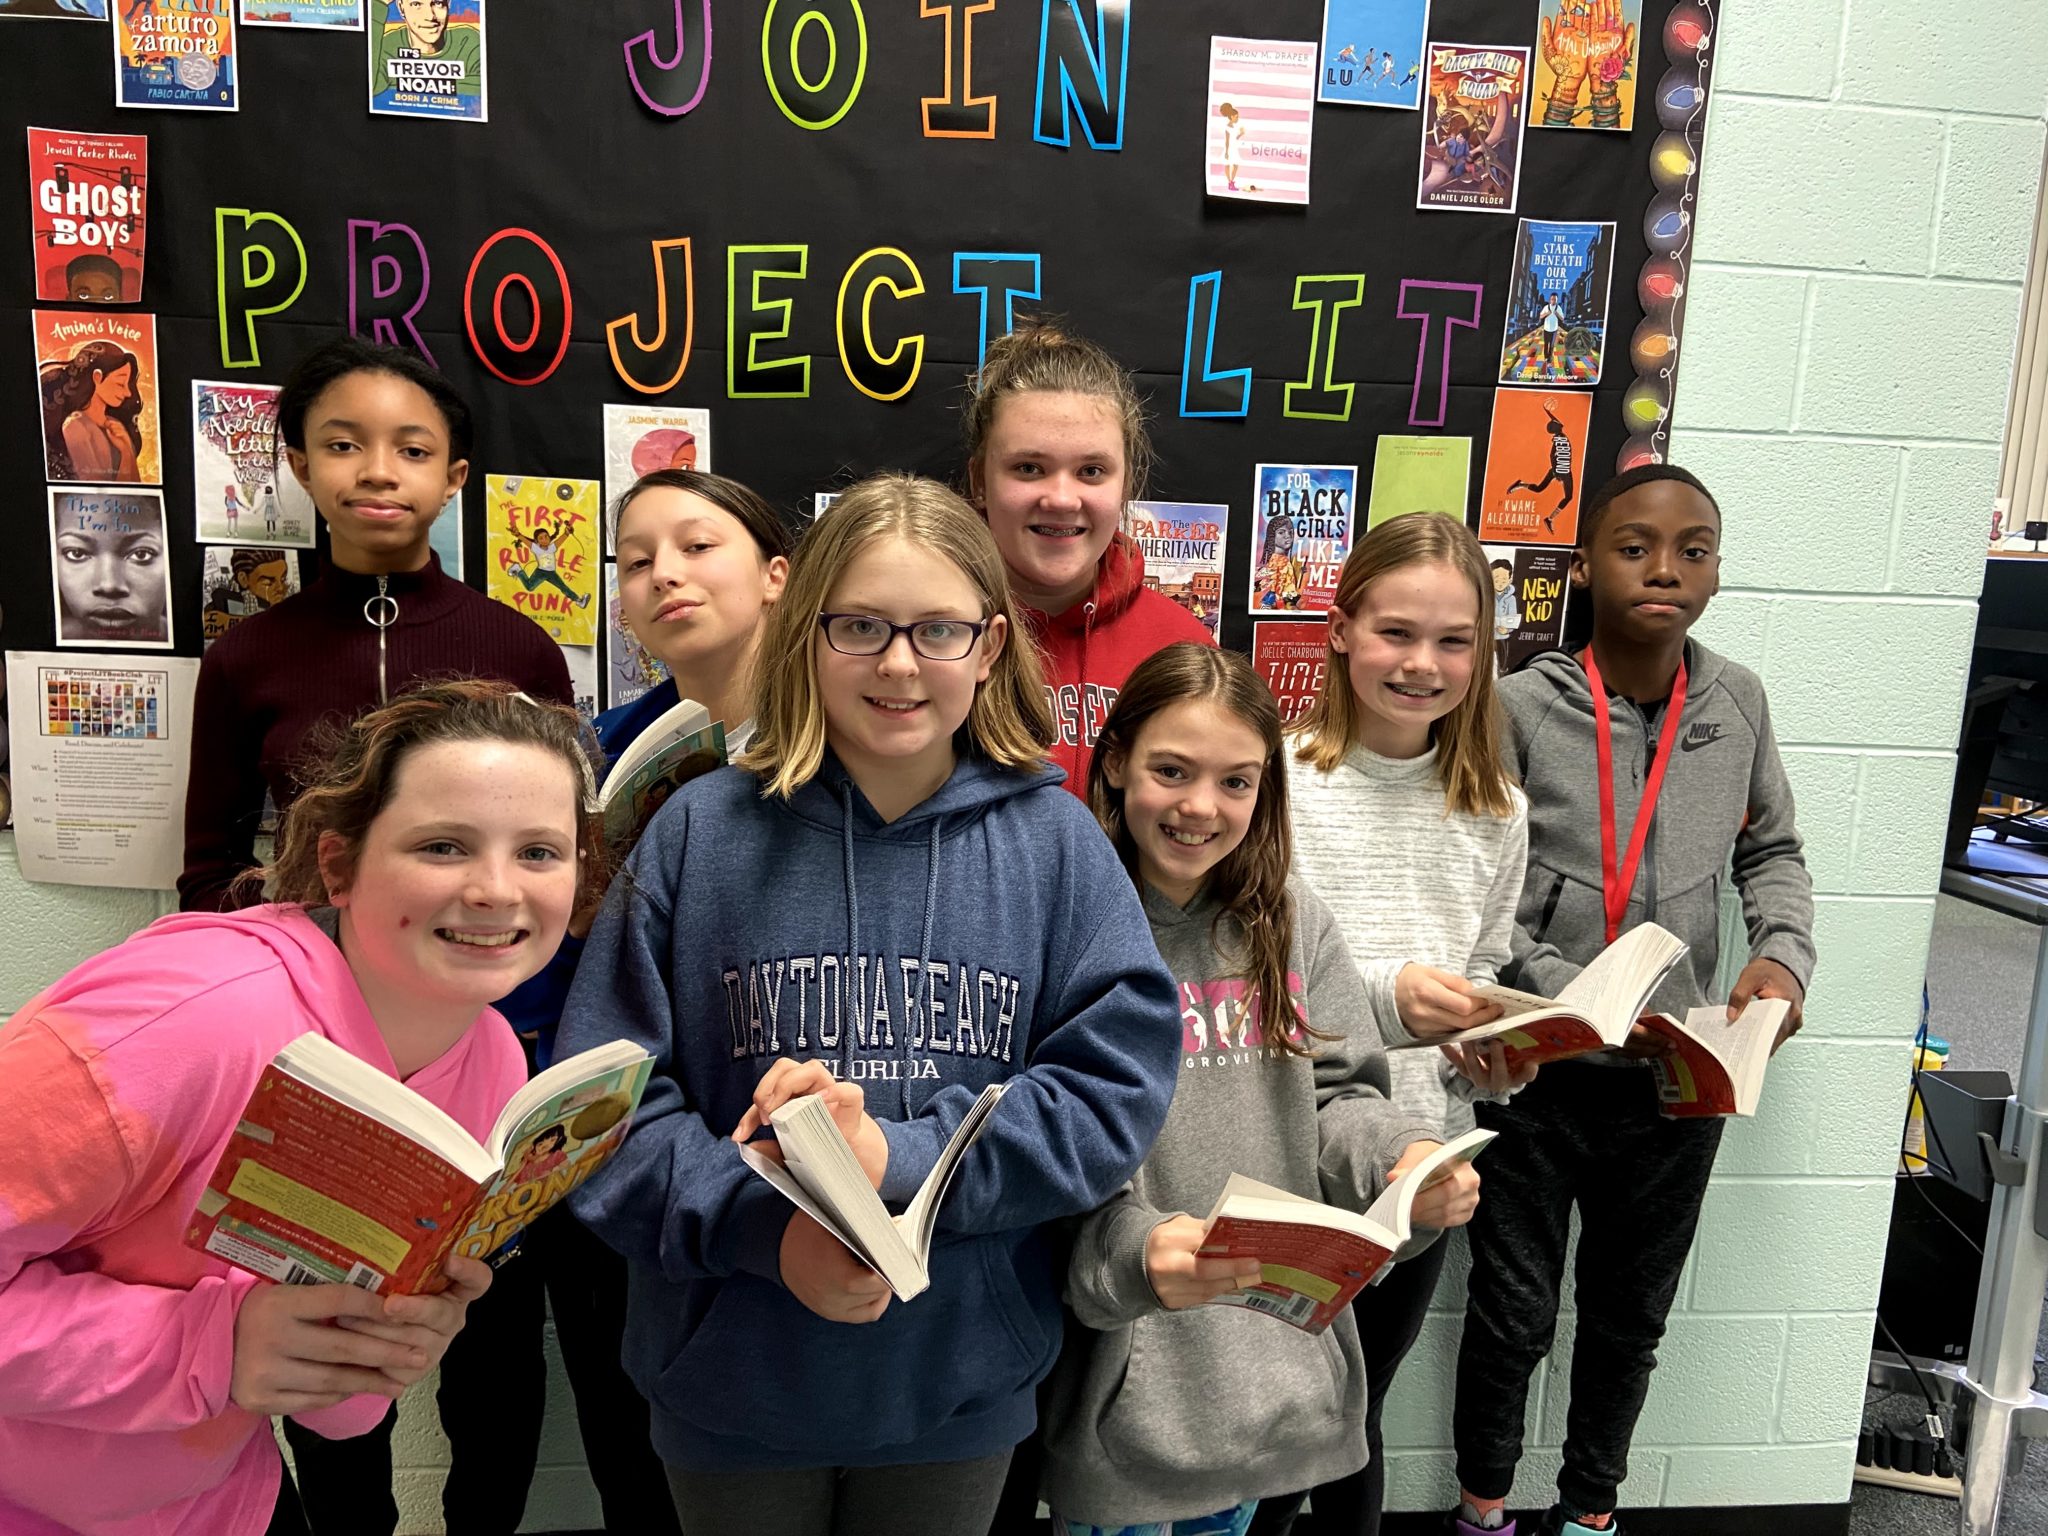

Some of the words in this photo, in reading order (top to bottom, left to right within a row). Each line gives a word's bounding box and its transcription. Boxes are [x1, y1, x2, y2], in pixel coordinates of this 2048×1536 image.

[140, 13, 219, 36] arturo
[131, 34, 220, 55] zamora
[399, 48, 420, 58] IT'S
[1221, 48, 1257, 58] SHARON
[1261, 51, 1272, 59] M.
[1275, 52, 1309, 62] DRAPER
[1443, 51, 1489, 73] DACTYL
[1491, 54, 1518, 76] HILL
[390, 62, 461, 77] TREVOR
[624, 0, 1130, 151] JOIN
[1326, 67, 1353, 87] LU
[148, 88, 172, 99] PABLO
[399, 78, 456, 95] NOAH:
[1457, 81, 1500, 99] SQUAD
[395, 93, 420, 103] BORN
[422, 95, 429, 103] A
[431, 96, 460, 106] CRIME
[45, 142, 72, 156] Jewell
[77, 145, 105, 160] Parker
[108, 148, 137, 160] Rhodes
[1251, 143, 1303, 160] blended
[40, 179, 141, 218] GHOST
[1430, 193, 1458, 203] DANIEL
[1480, 195, 1504, 205] OLDER
[52, 218, 130, 250] BOYS
[1553, 235, 1567, 243] THE
[1543, 243, 1575, 255] STARS
[1534, 254, 1583, 267] BENEATH
[1546, 267, 1567, 279] OUR
[1543, 278, 1569, 290] FEET
[215, 207, 1041, 401] PROJECT
[1179, 270, 1483, 427] LIT
[50, 318, 104, 341] Amina's
[107, 318, 142, 342] Voice
[211, 391, 269, 419] Ivy
[627, 416, 659, 426] JASMINE
[662, 416, 689, 427] WARGA
[237, 455, 249, 468] to
[1553, 436, 1571, 474] REBOUND
[1287, 472, 1312, 489] FOR
[66, 496, 99, 513] The
[104, 499, 141, 515] Skin
[1266, 488, 1346, 517] BLACK
[1504, 499, 1536, 513] KWAME
[79, 515, 107, 532] I'm
[112, 516, 132, 533] In
[508, 505, 587, 530] FIRST
[1171, 519, 1190, 529] The
[1486, 512, 1541, 527] ALEXANDER
[1131, 519, 1220, 542] PARKER
[1297, 518, 1345, 539] GIRLS
[1136, 538, 1218, 560] NHERITANCE
[1296, 539, 1343, 564] LIKE
[498, 547, 588, 574] RULE
[563, 571, 577, 582] OF
[1308, 564, 1339, 589] ME
[1522, 577, 1561, 601] NEW
[512, 591, 573, 617] PUNK
[1518, 631, 1535, 641] JERRY
[1536, 632, 1554, 642] CRAFT
[1261, 646, 1285, 659] JOELLE
[1268, 662, 1327, 691] TIME
[1689, 723, 1721, 740] NIKE
[722, 954, 894, 1058] DAYTONA
[899, 956, 1020, 1063] BEACH
[819, 1059, 941, 1080] LORIDA
